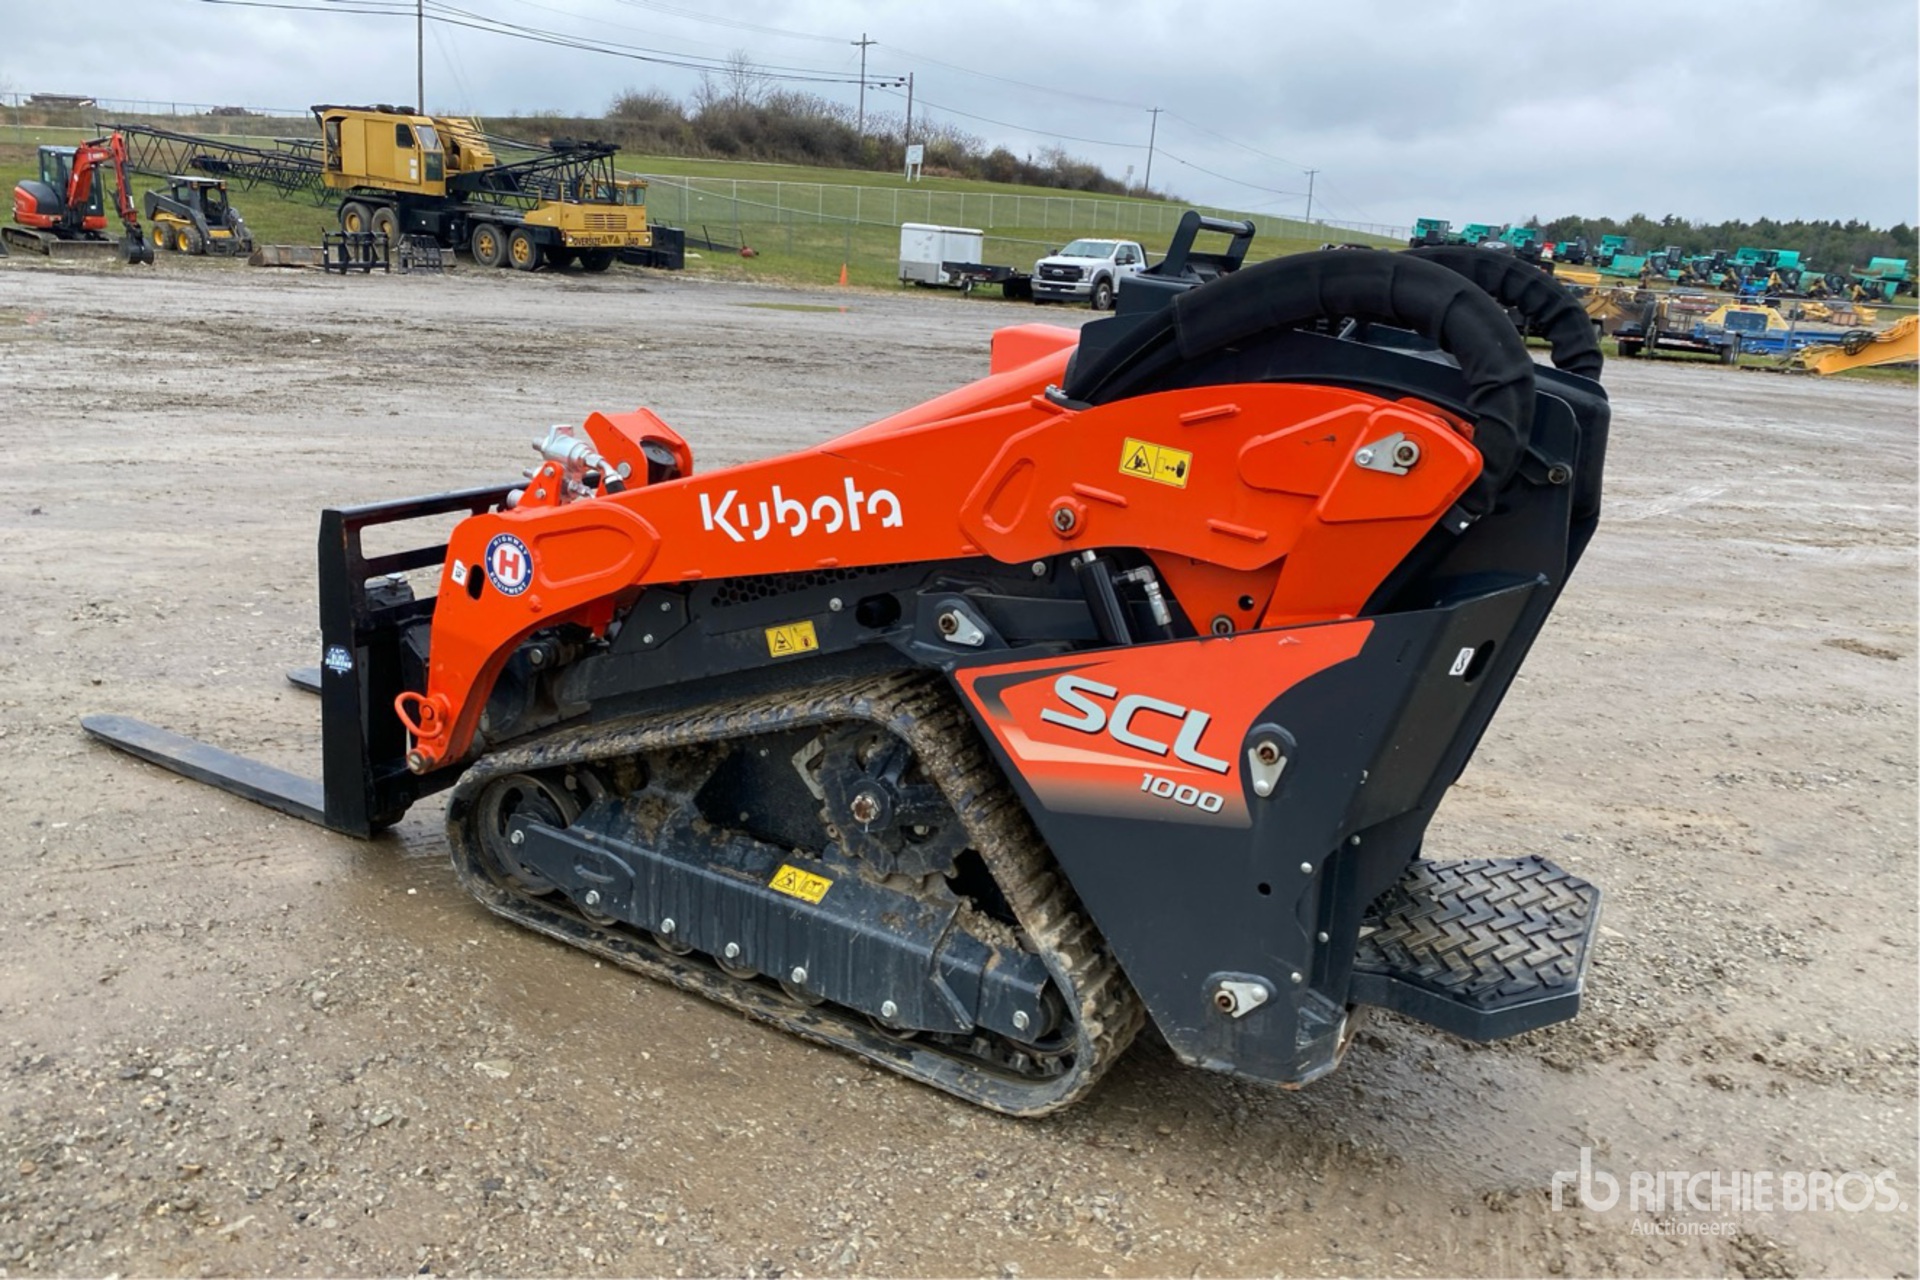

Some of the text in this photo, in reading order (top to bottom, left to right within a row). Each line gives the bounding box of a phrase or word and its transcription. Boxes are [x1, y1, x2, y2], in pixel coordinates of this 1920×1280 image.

[573, 237, 639, 246] OVERSIZE LOAD
[699, 477, 903, 542] Kubota
[493, 535, 527, 555] HIGHWAY
[499, 549, 520, 580] H
[490, 572, 526, 596] EQUIPMENT
[1040, 674, 1230, 774] SCL
[1140, 773, 1224, 814] 1000
